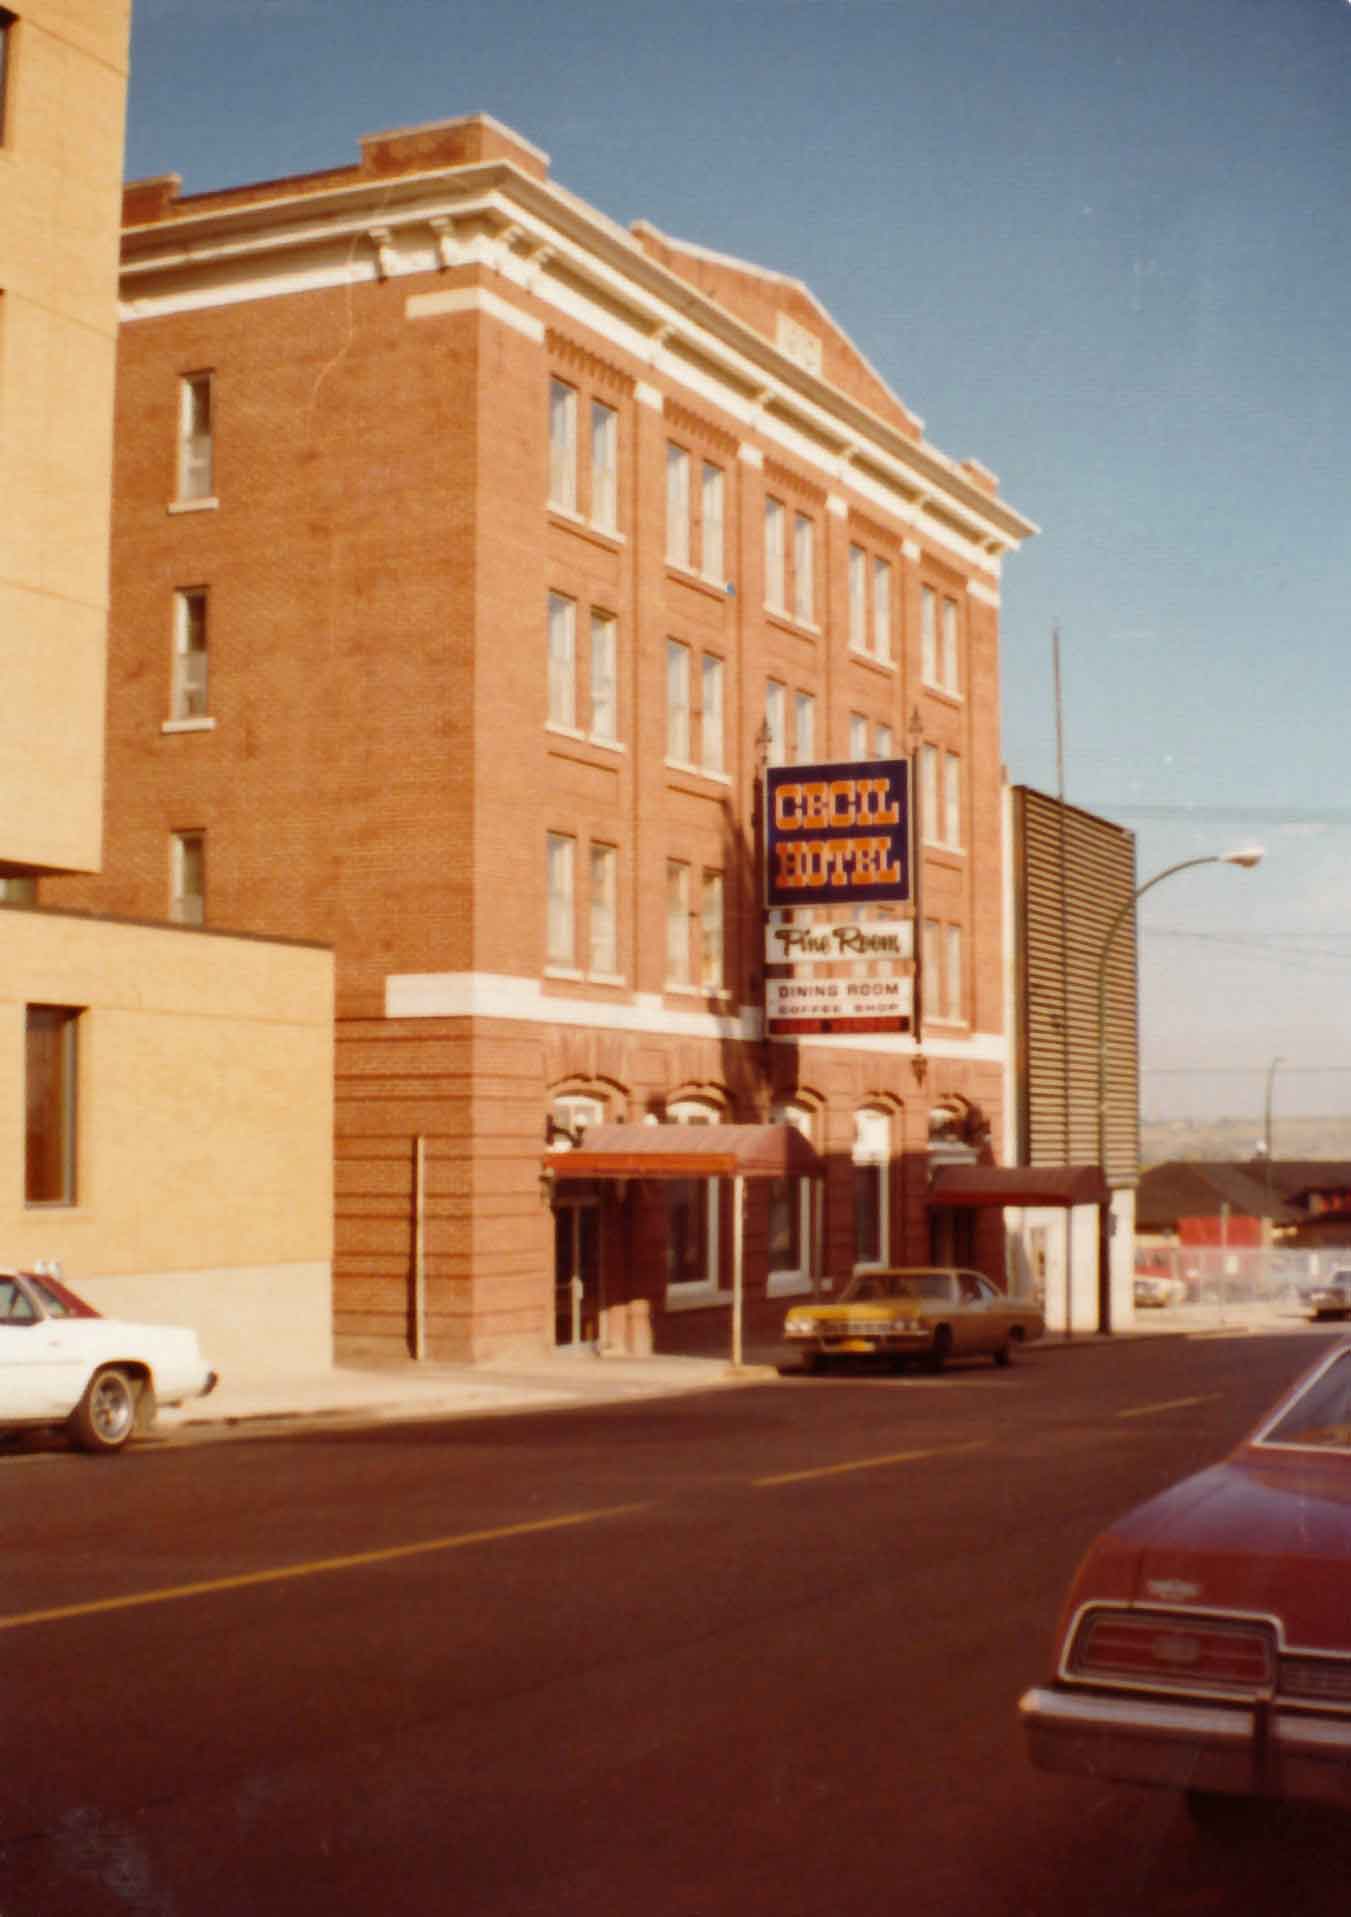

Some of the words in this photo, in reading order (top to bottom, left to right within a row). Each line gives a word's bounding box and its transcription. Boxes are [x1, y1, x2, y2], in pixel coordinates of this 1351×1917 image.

[775, 778, 900, 830] CECIL
[775, 836, 901, 888] HOTEL
[778, 985, 838, 998] DINING
[847, 983, 899, 996] ROOM
